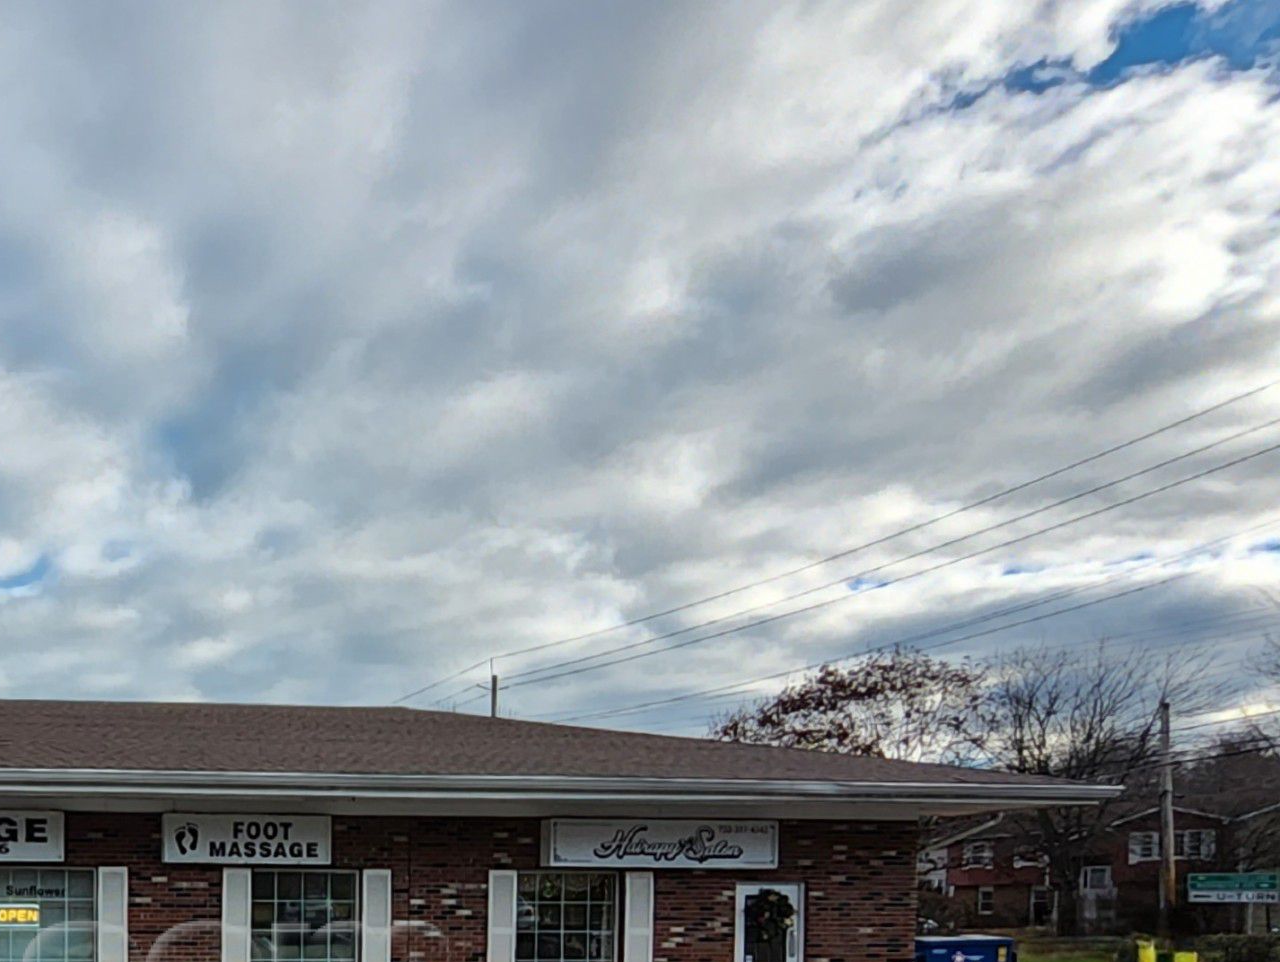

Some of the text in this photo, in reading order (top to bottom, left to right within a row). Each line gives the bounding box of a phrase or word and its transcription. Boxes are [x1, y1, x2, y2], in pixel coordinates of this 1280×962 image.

[233, 821, 293, 840] FOOT
[209, 841, 319, 858] MASSAGE
[6, 885, 66, 896] Sunflower
[0, 909, 38, 922] OPEN
